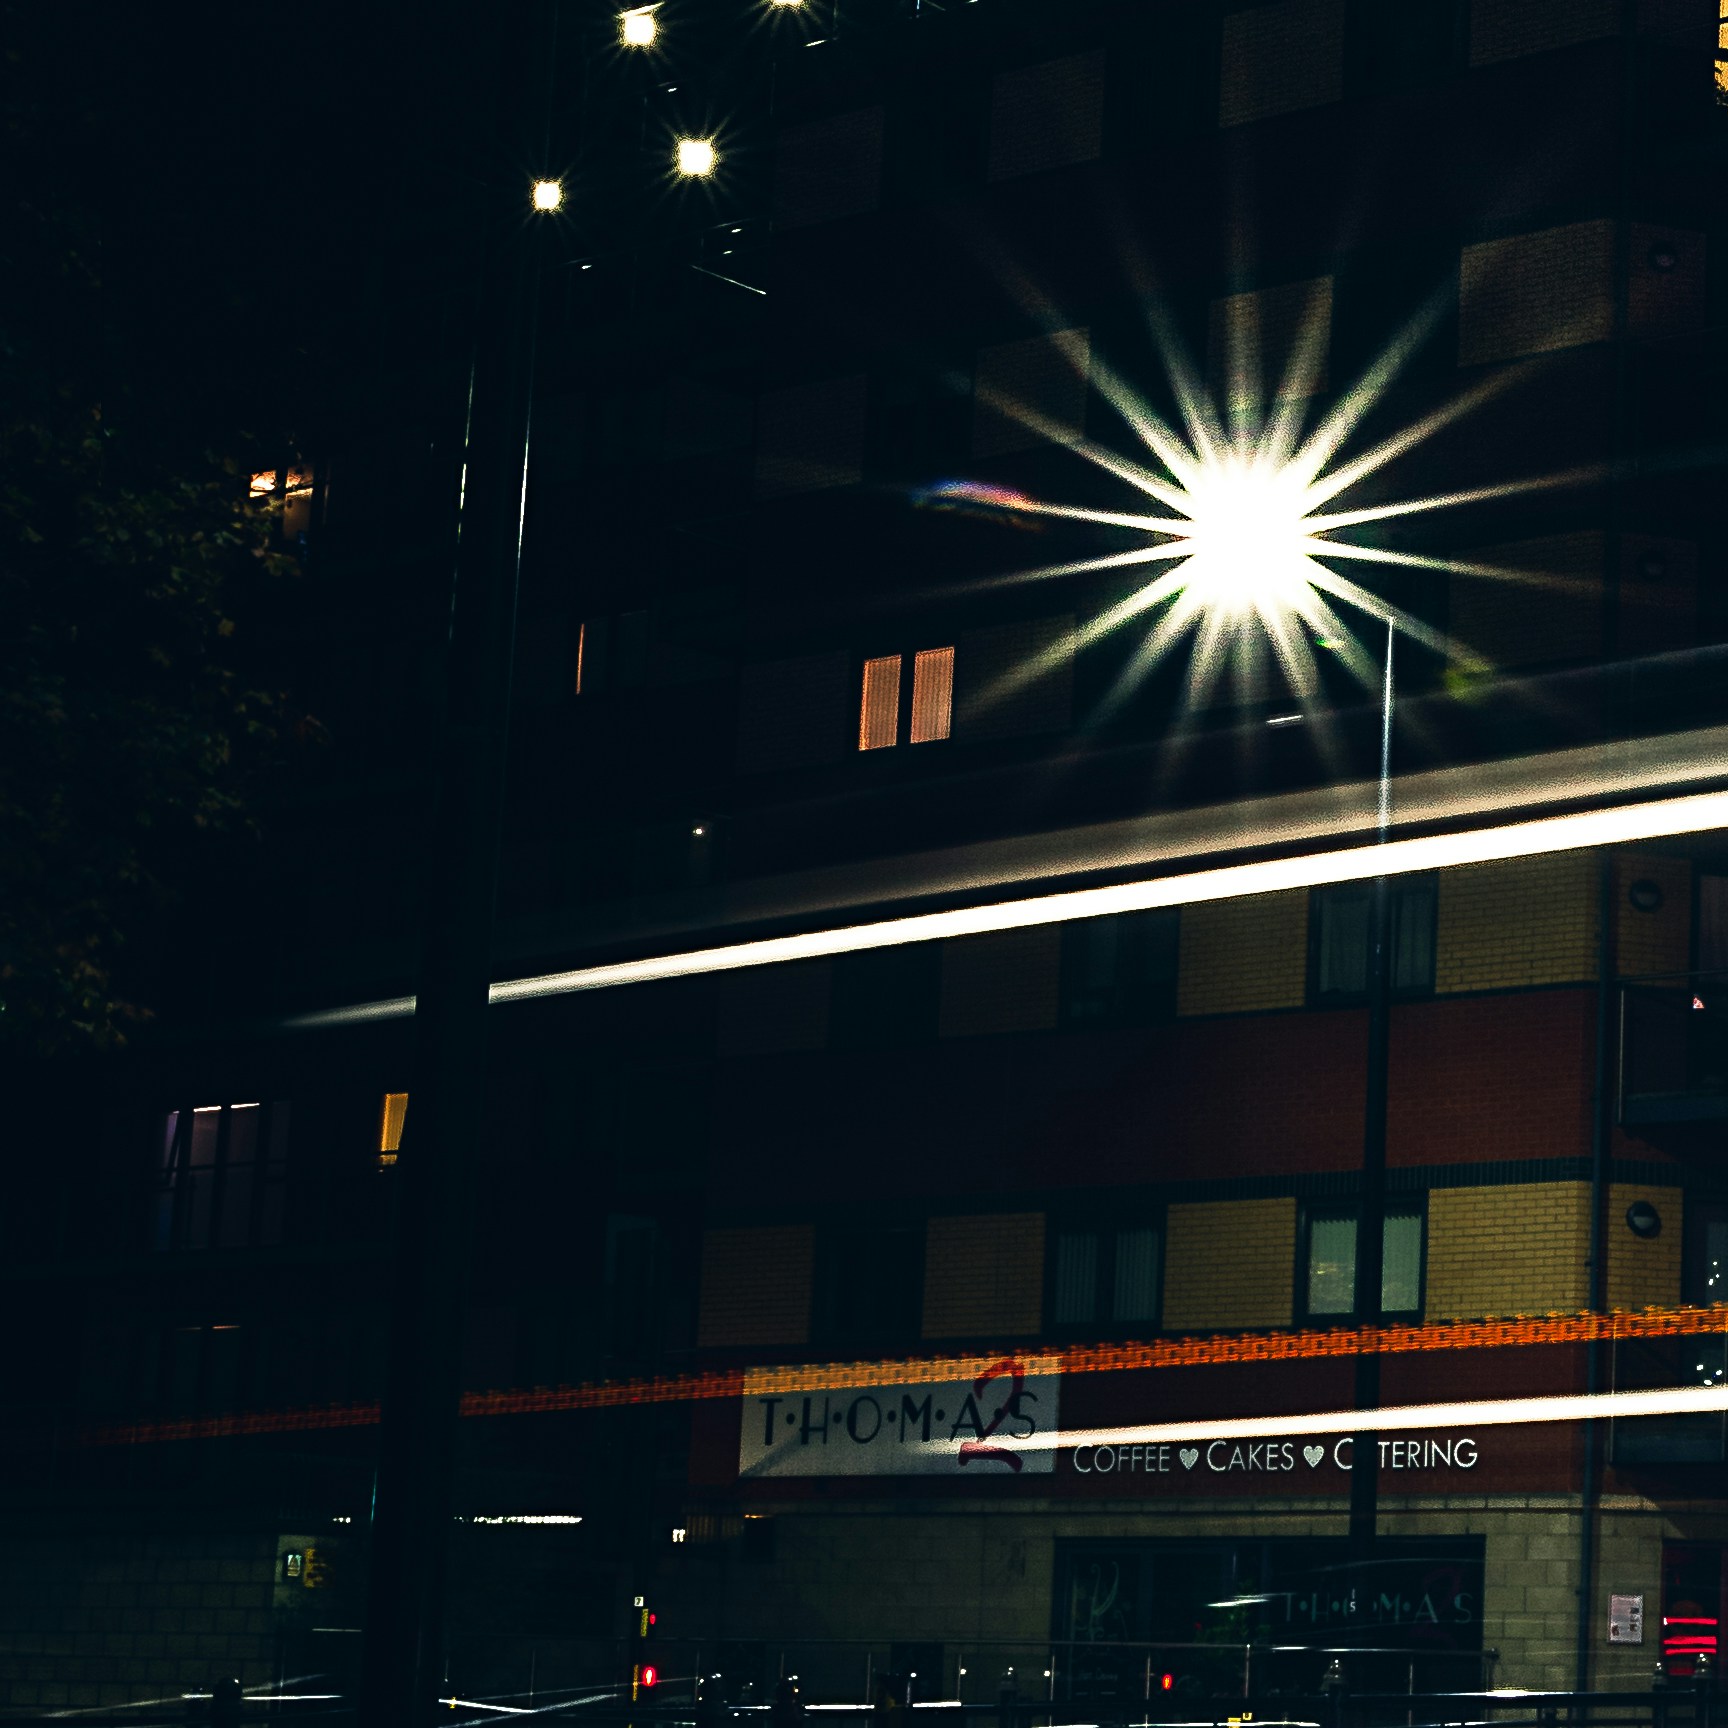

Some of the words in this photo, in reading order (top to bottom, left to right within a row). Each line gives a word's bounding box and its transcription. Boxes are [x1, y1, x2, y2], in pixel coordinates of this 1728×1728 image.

[1073, 1443, 1171, 1473] COFFEE
[1206, 1440, 1295, 1472] CAKES
[1334, 1437, 1479, 1470] CTERING
